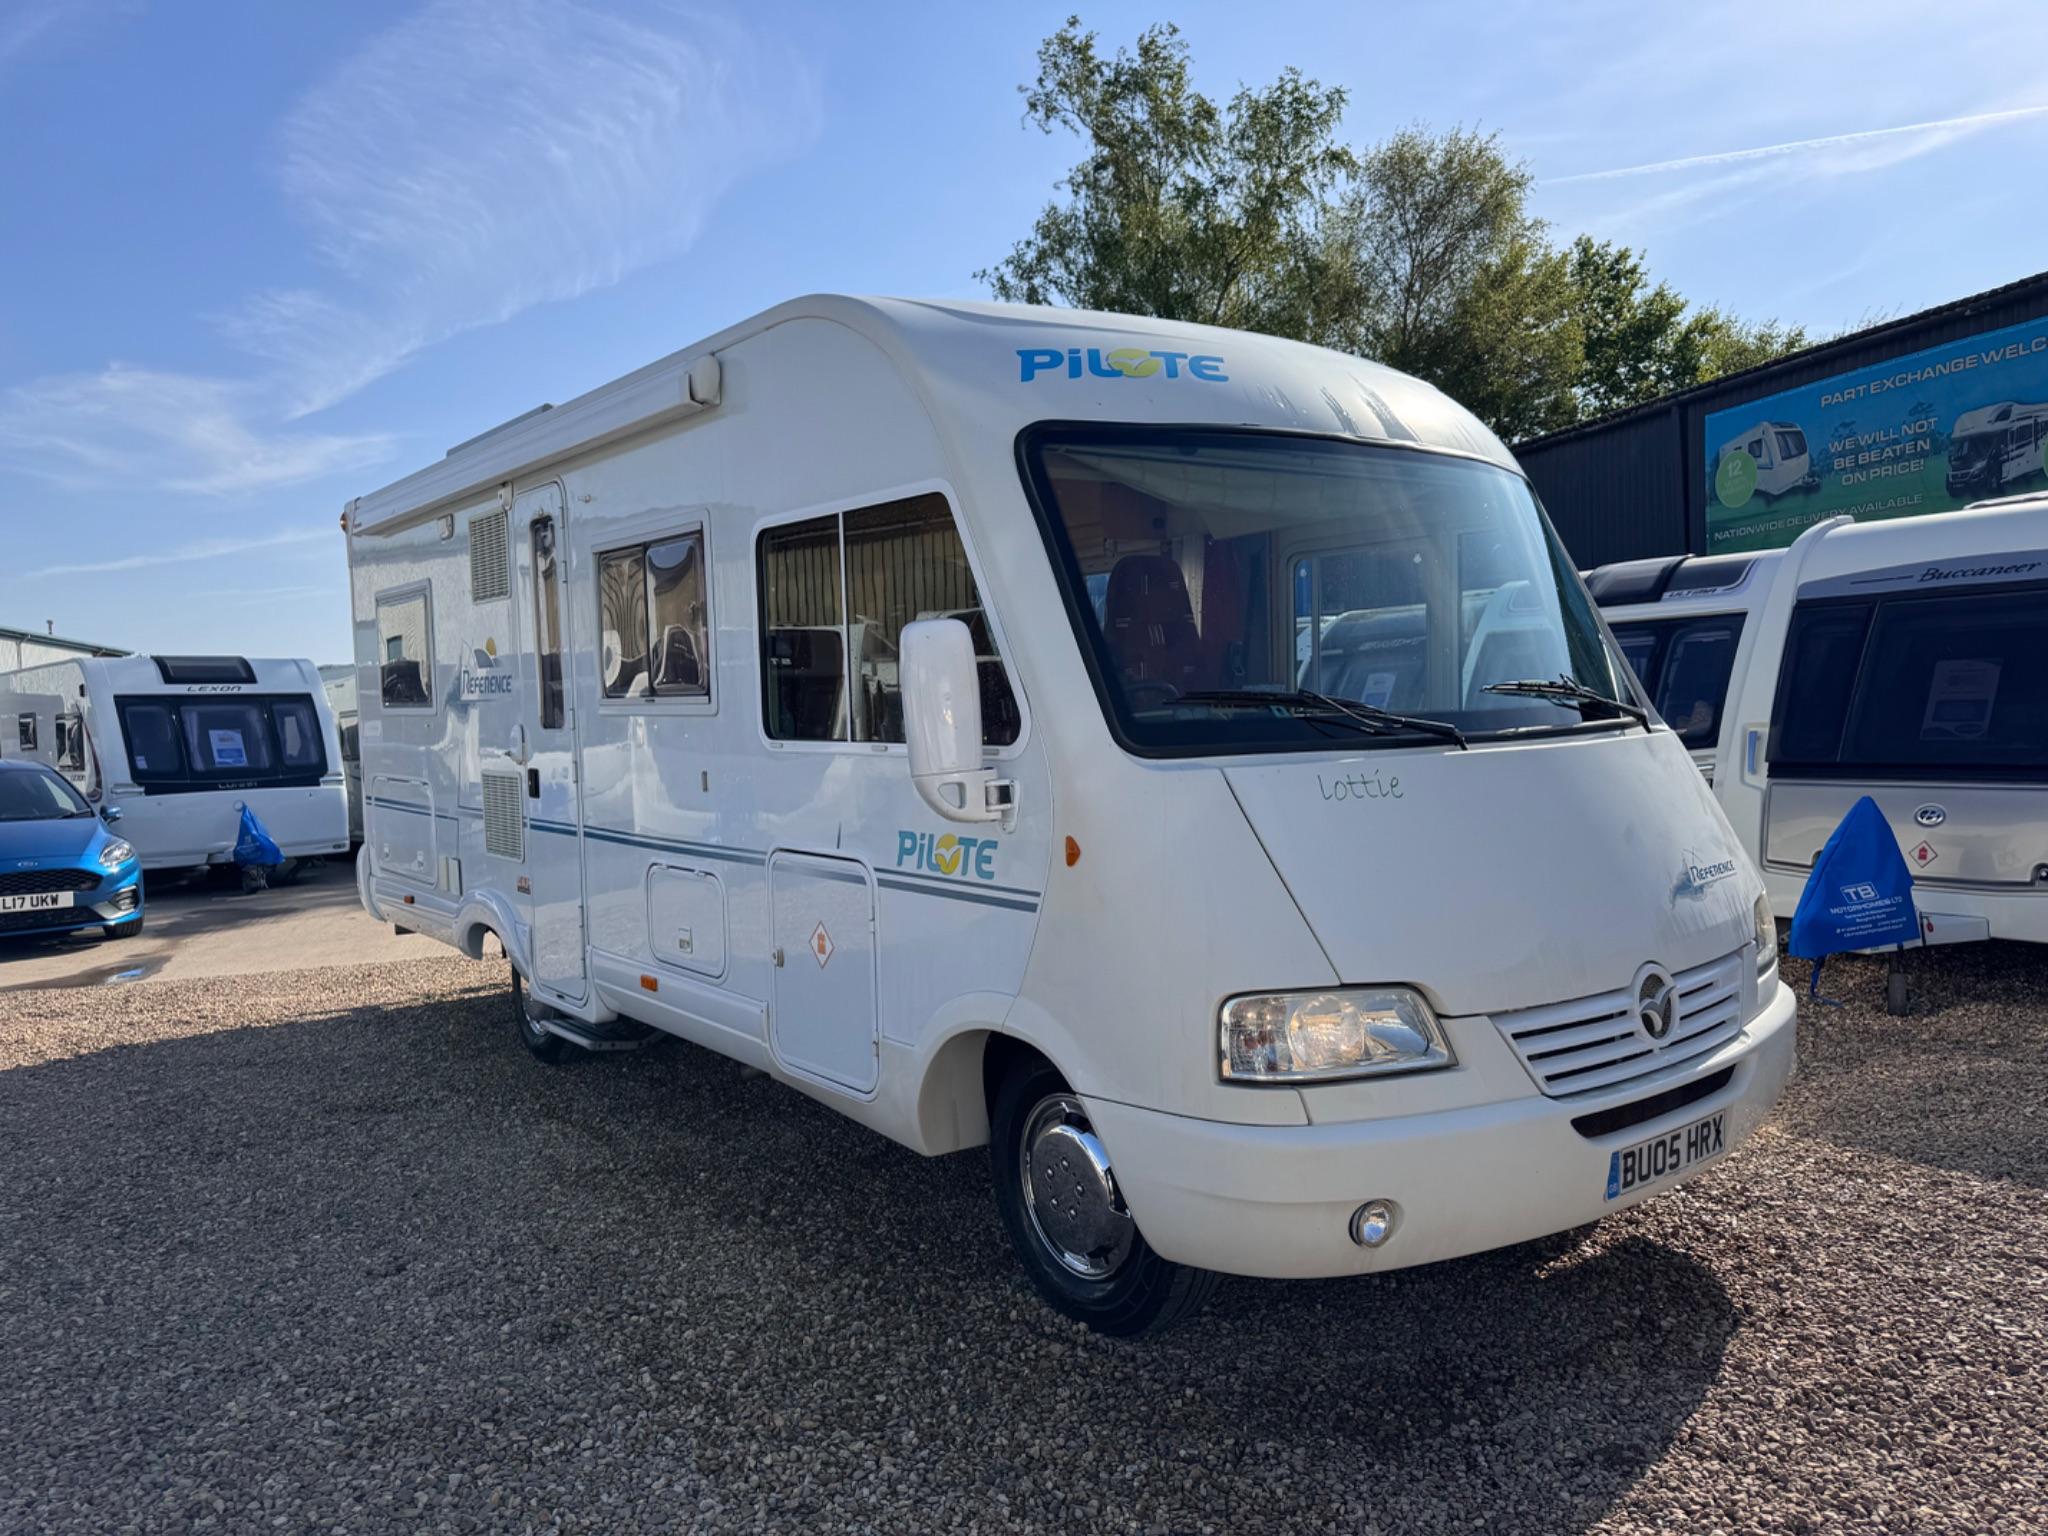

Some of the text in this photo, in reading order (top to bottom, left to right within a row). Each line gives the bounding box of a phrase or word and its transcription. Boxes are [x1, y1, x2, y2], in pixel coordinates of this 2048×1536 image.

[1820, 336, 2048, 408] PART EXCHANGE WELC
[1828, 417, 1938, 453] WE WILL NOT
[1728, 459, 1744, 478] 12
[1833, 437, 1930, 470] BE BEATEN
[1842, 458, 1925, 486] ON PRICE!
[1714, 494, 1923, 542] NATIONWIDE DELIVERY AVAILABLE
[1918, 561, 2042, 584] Buccaneer
[30, 893, 60, 908] UKW
[1843, 885, 1876, 901] TB
[1621, 1114, 1723, 1189] BU05 HRX
